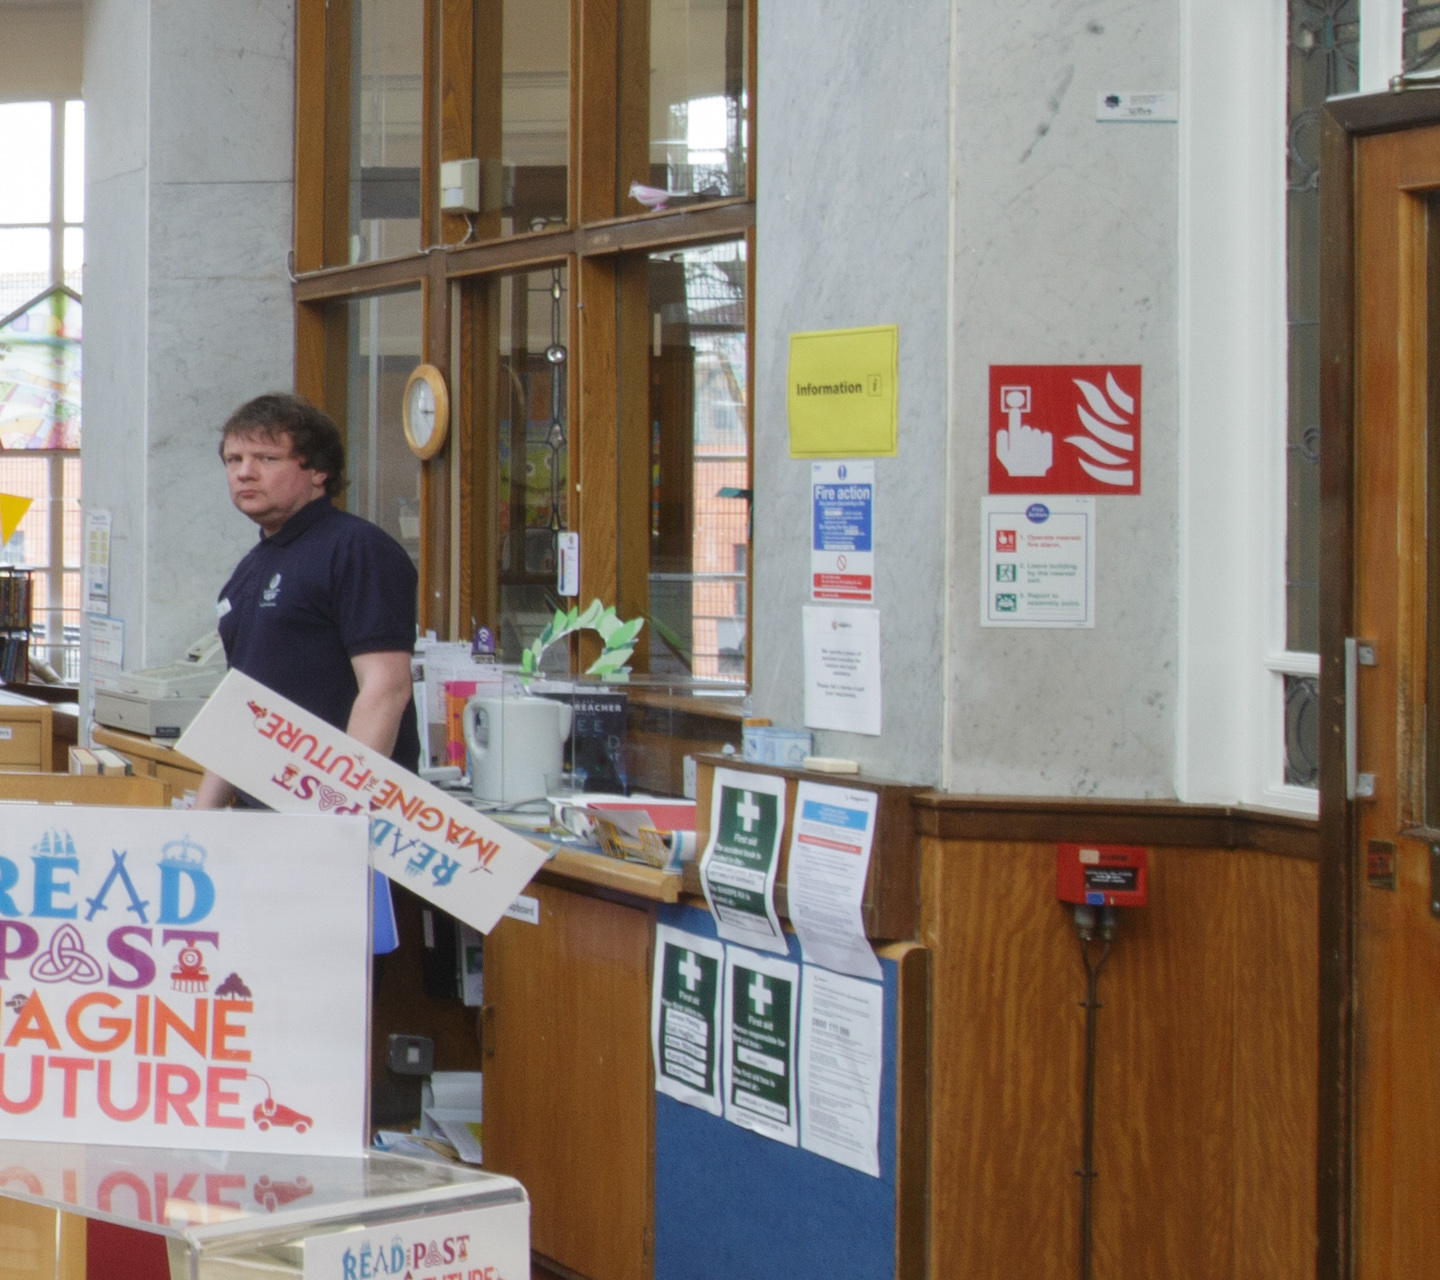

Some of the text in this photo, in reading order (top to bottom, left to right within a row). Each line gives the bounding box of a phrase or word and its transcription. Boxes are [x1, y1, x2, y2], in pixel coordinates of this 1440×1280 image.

[796, 381, 863, 397] Information
[815, 485, 870, 500] Fire action
[256, 710, 368, 792] FUTURE
[376, 779, 503, 867] IMAGINE
